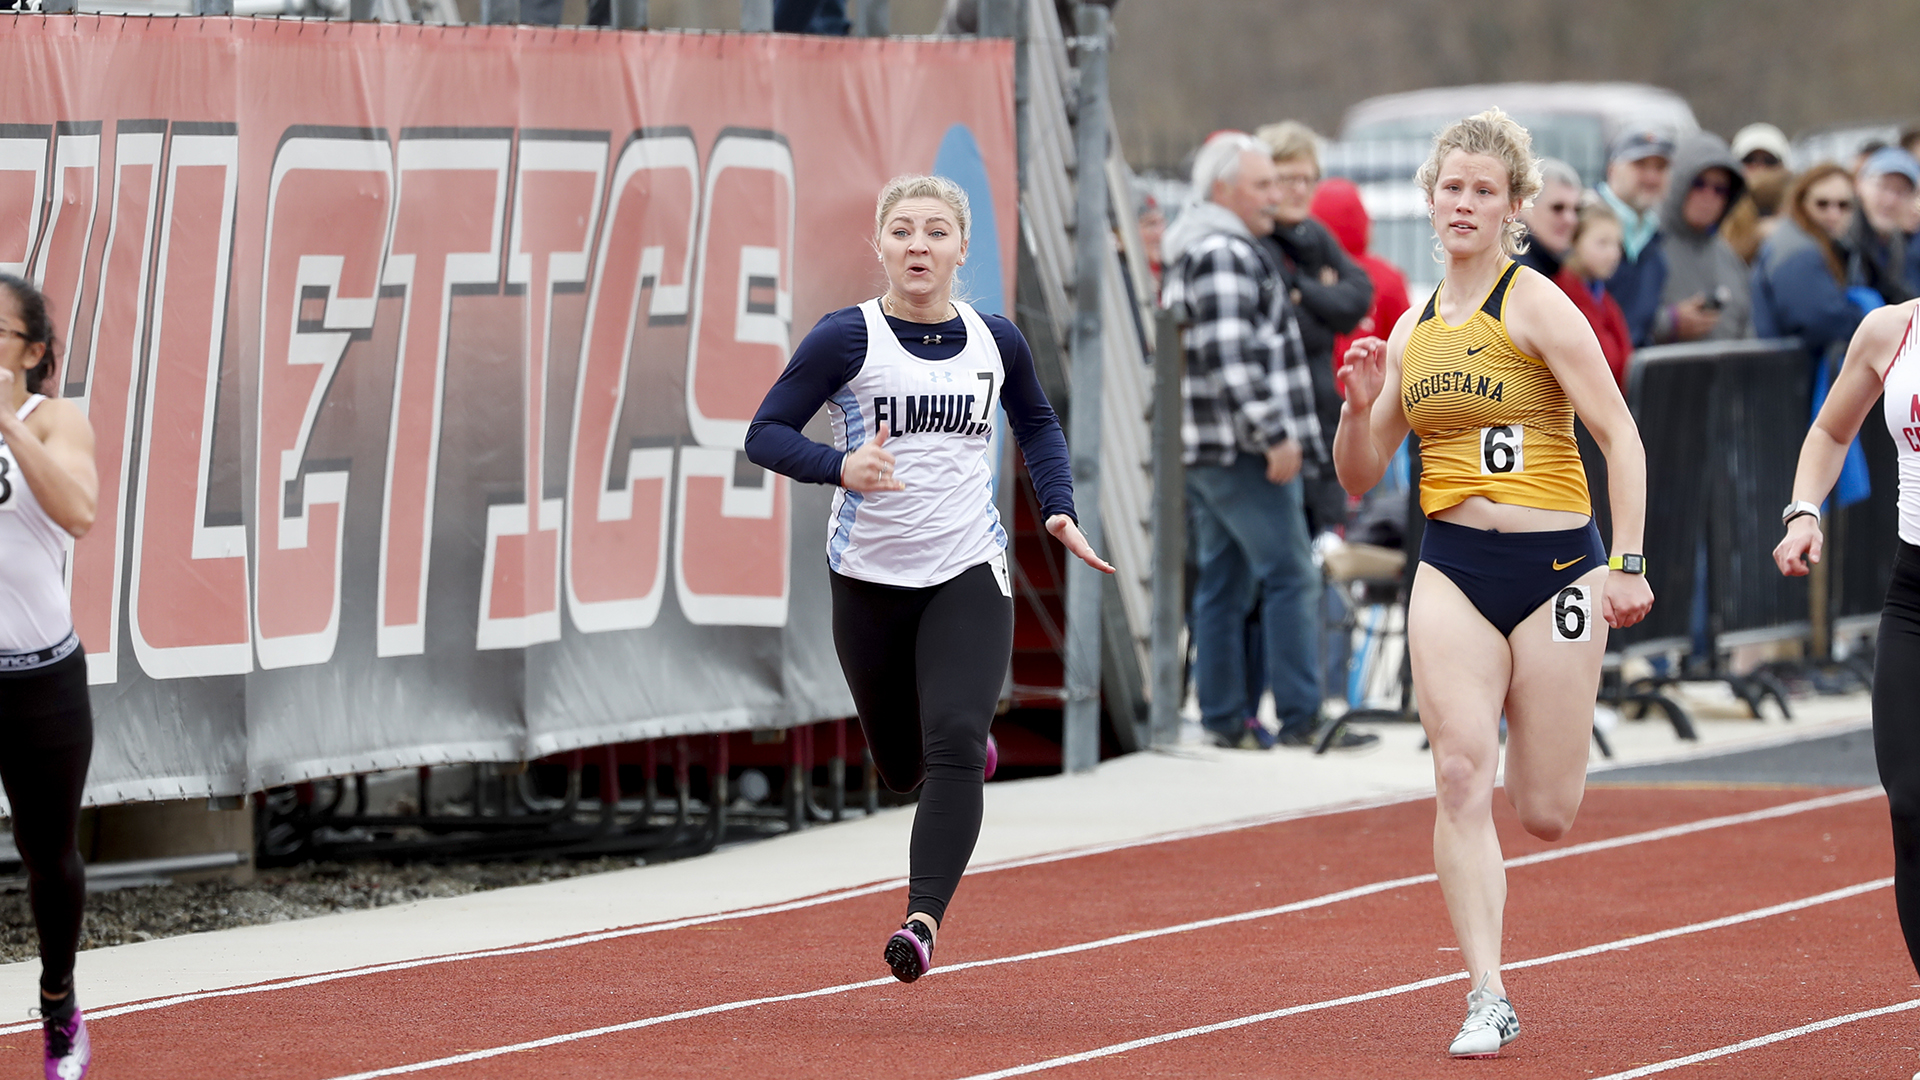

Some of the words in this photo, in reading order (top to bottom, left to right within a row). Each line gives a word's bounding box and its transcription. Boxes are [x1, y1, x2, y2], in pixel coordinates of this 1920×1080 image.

[873, 394, 992, 438] ELMHUR
[976, 371, 995, 420] 7
[1404, 371, 1504, 412] AUGUSTANA
[1484, 425, 1516, 474] 6
[1555, 586, 1586, 640] 6
